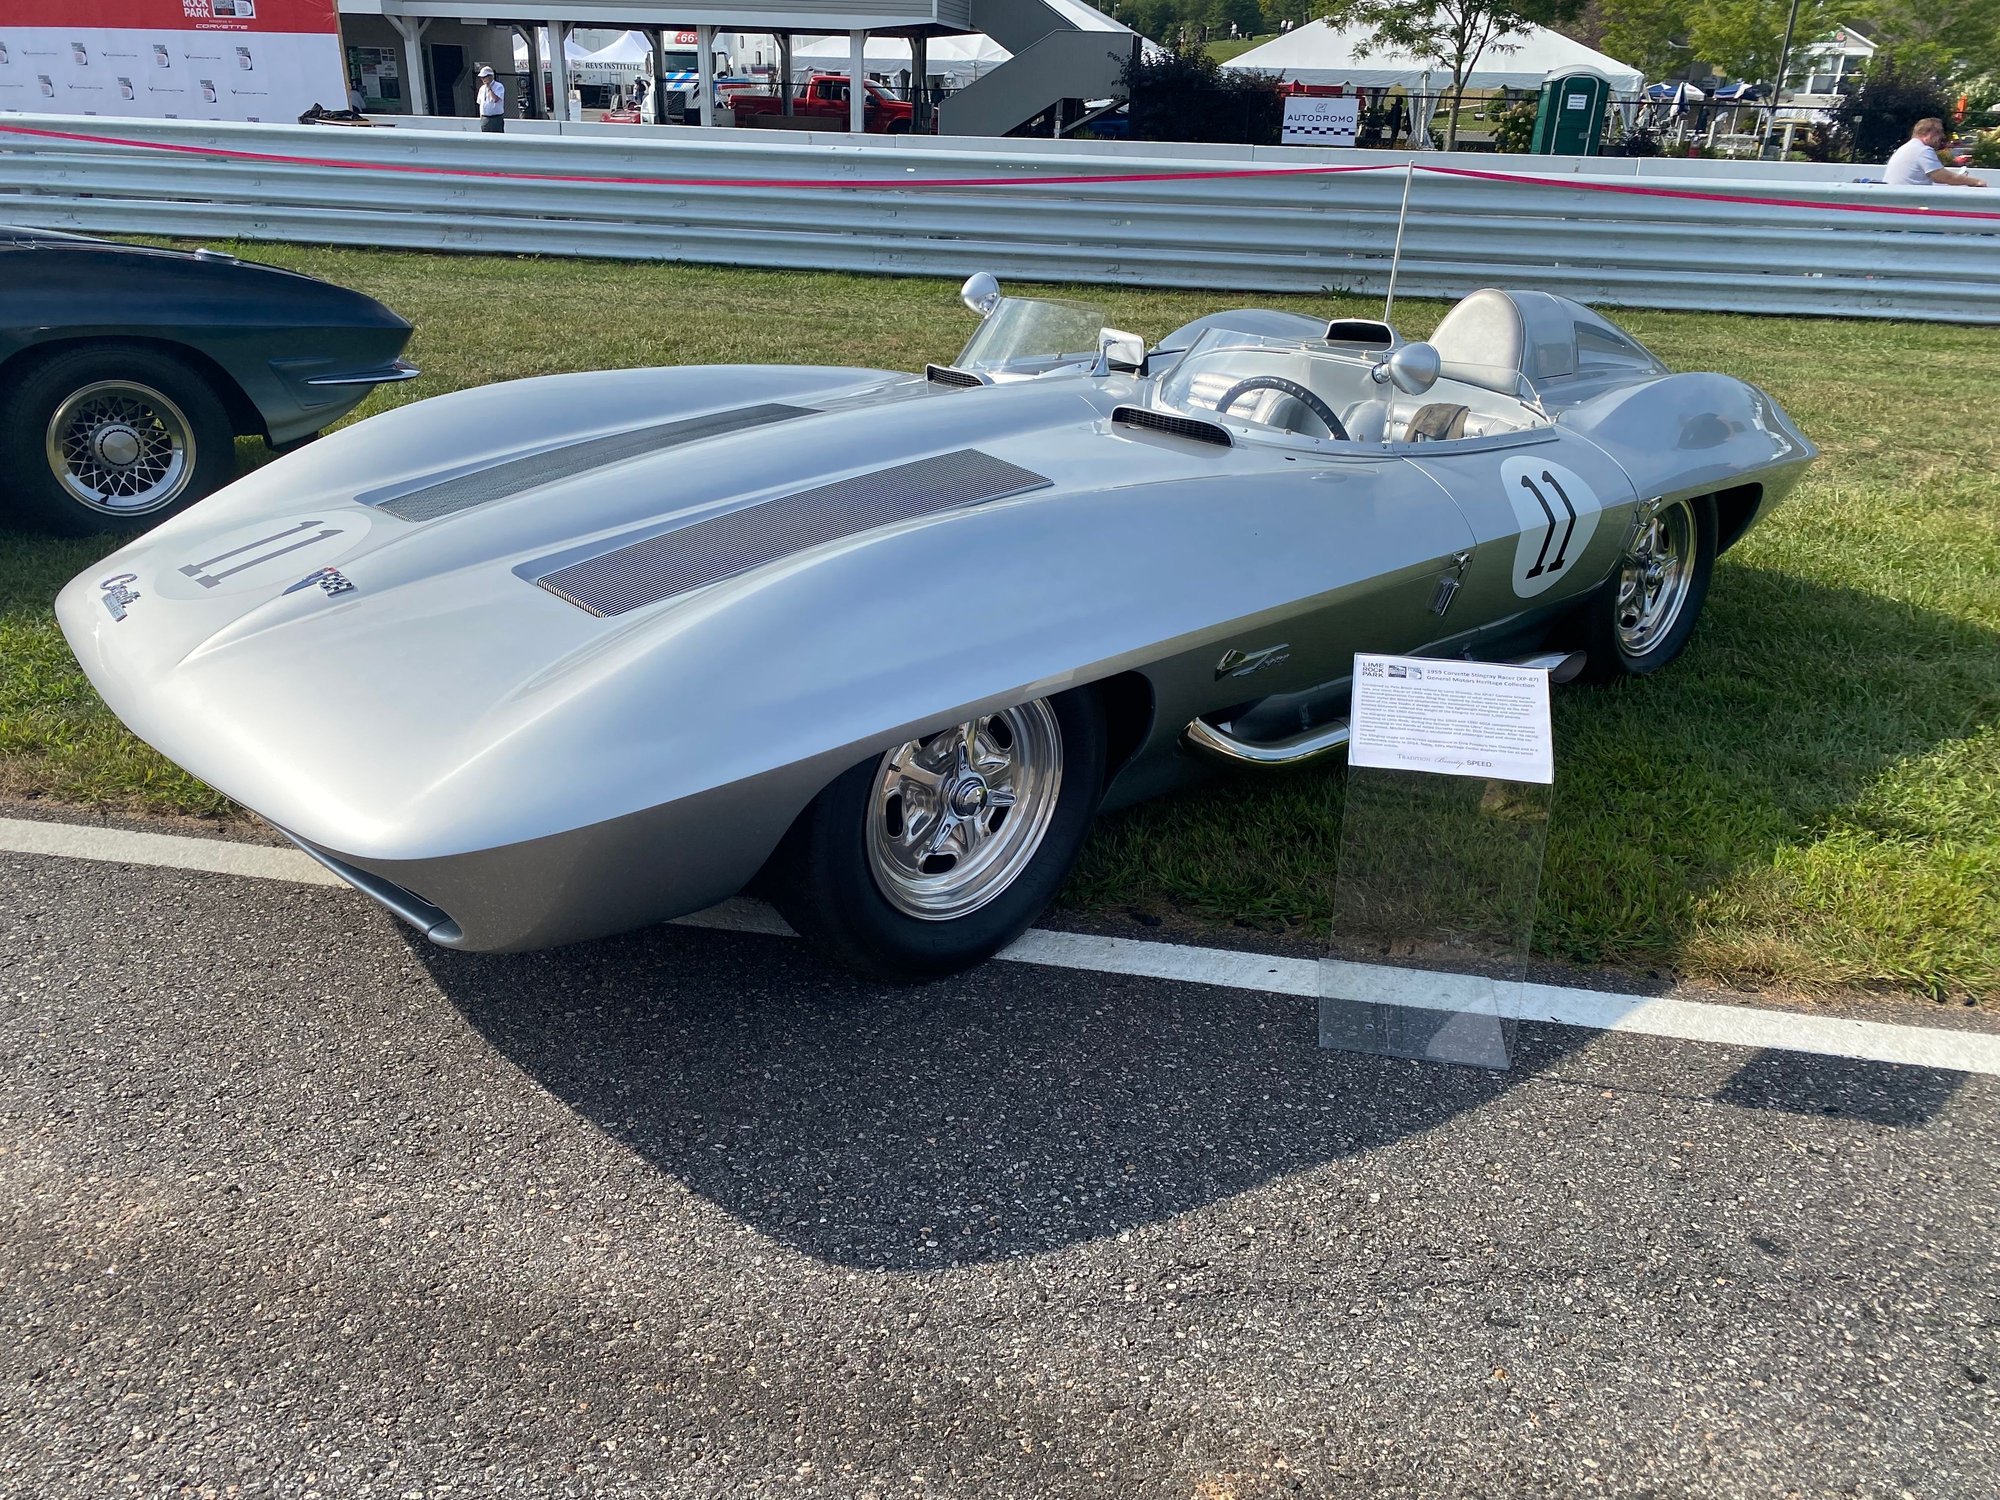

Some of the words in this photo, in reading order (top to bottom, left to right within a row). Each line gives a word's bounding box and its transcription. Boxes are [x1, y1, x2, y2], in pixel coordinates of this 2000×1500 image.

[182, 0, 209, 8] ROCK
[183, 8, 211, 18] PARK
[681, 33, 695, 43] 66
[604, 63, 641, 71] INSTITUTE
[1287, 114, 1354, 123] AUTODROMO
[1521, 470, 1577, 580] 11
[177, 520, 345, 589] 11
